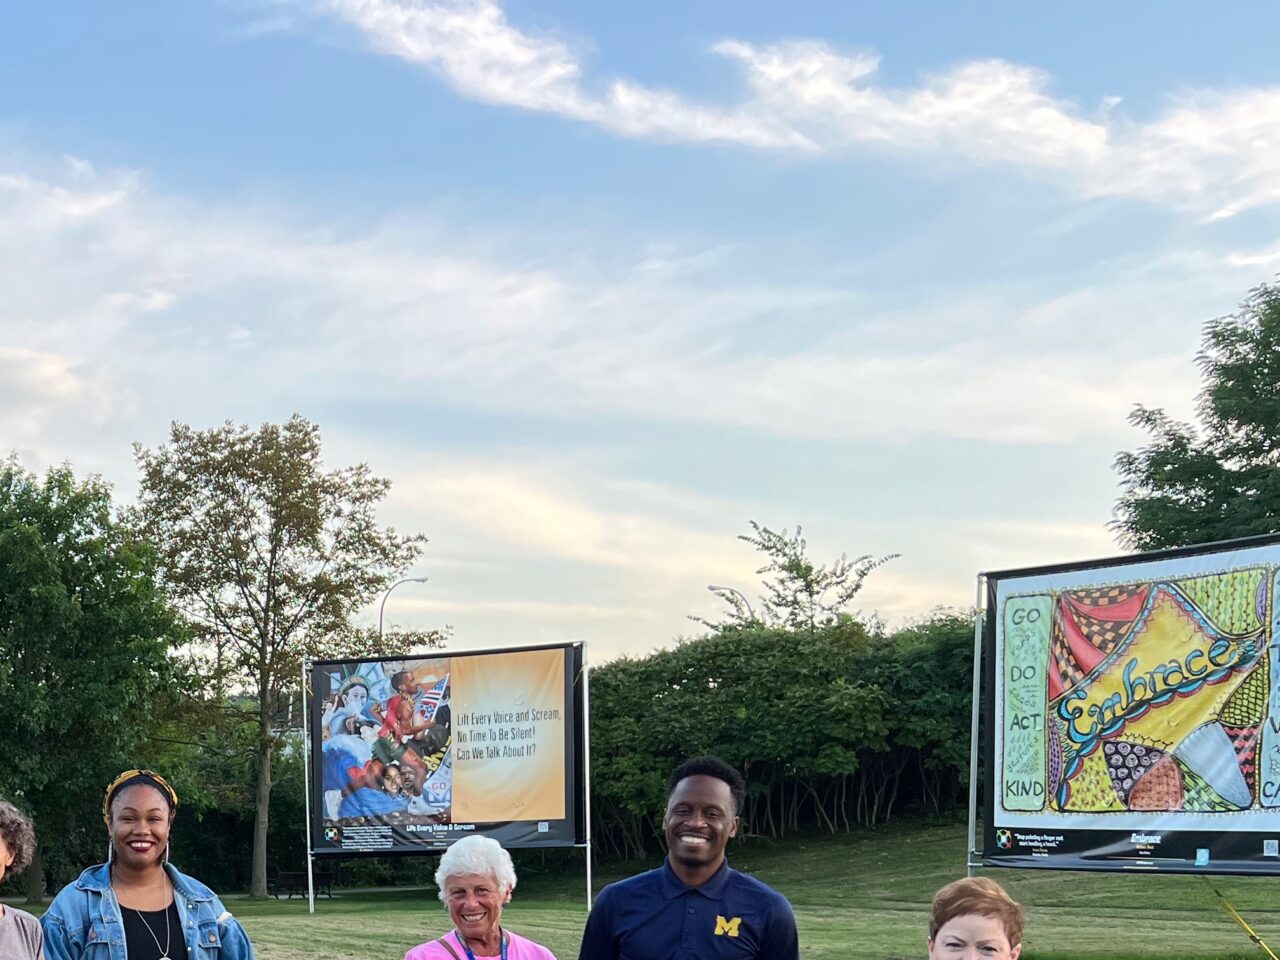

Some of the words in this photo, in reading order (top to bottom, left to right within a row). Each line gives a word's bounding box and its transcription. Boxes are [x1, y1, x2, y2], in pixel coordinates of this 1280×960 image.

[1012, 608, 1040, 625] GO
[1011, 665, 1035, 682] DO
[1057, 638, 1237, 743] Embrace
[457, 713, 469, 726] Lift
[471, 712, 491, 725] Every
[493, 711, 513, 724] Voice
[515, 709, 529, 722] and
[531, 708, 561, 721] Scream,
[1009, 713, 1041, 731] ACT
[457, 730, 467, 743] No
[469, 730, 486, 742] Time
[489, 728, 496, 741] To
[498, 728, 509, 741] Be
[510, 726, 535, 740] Silent!
[456, 747, 470, 760] Can
[472, 747, 484, 760] We
[486, 746, 500, 759] Talk
[503, 745, 524, 758] About
[526, 743, 536, 756] It?
[1006, 780, 1044, 798] KIND
[714, 914, 742, 937] M
